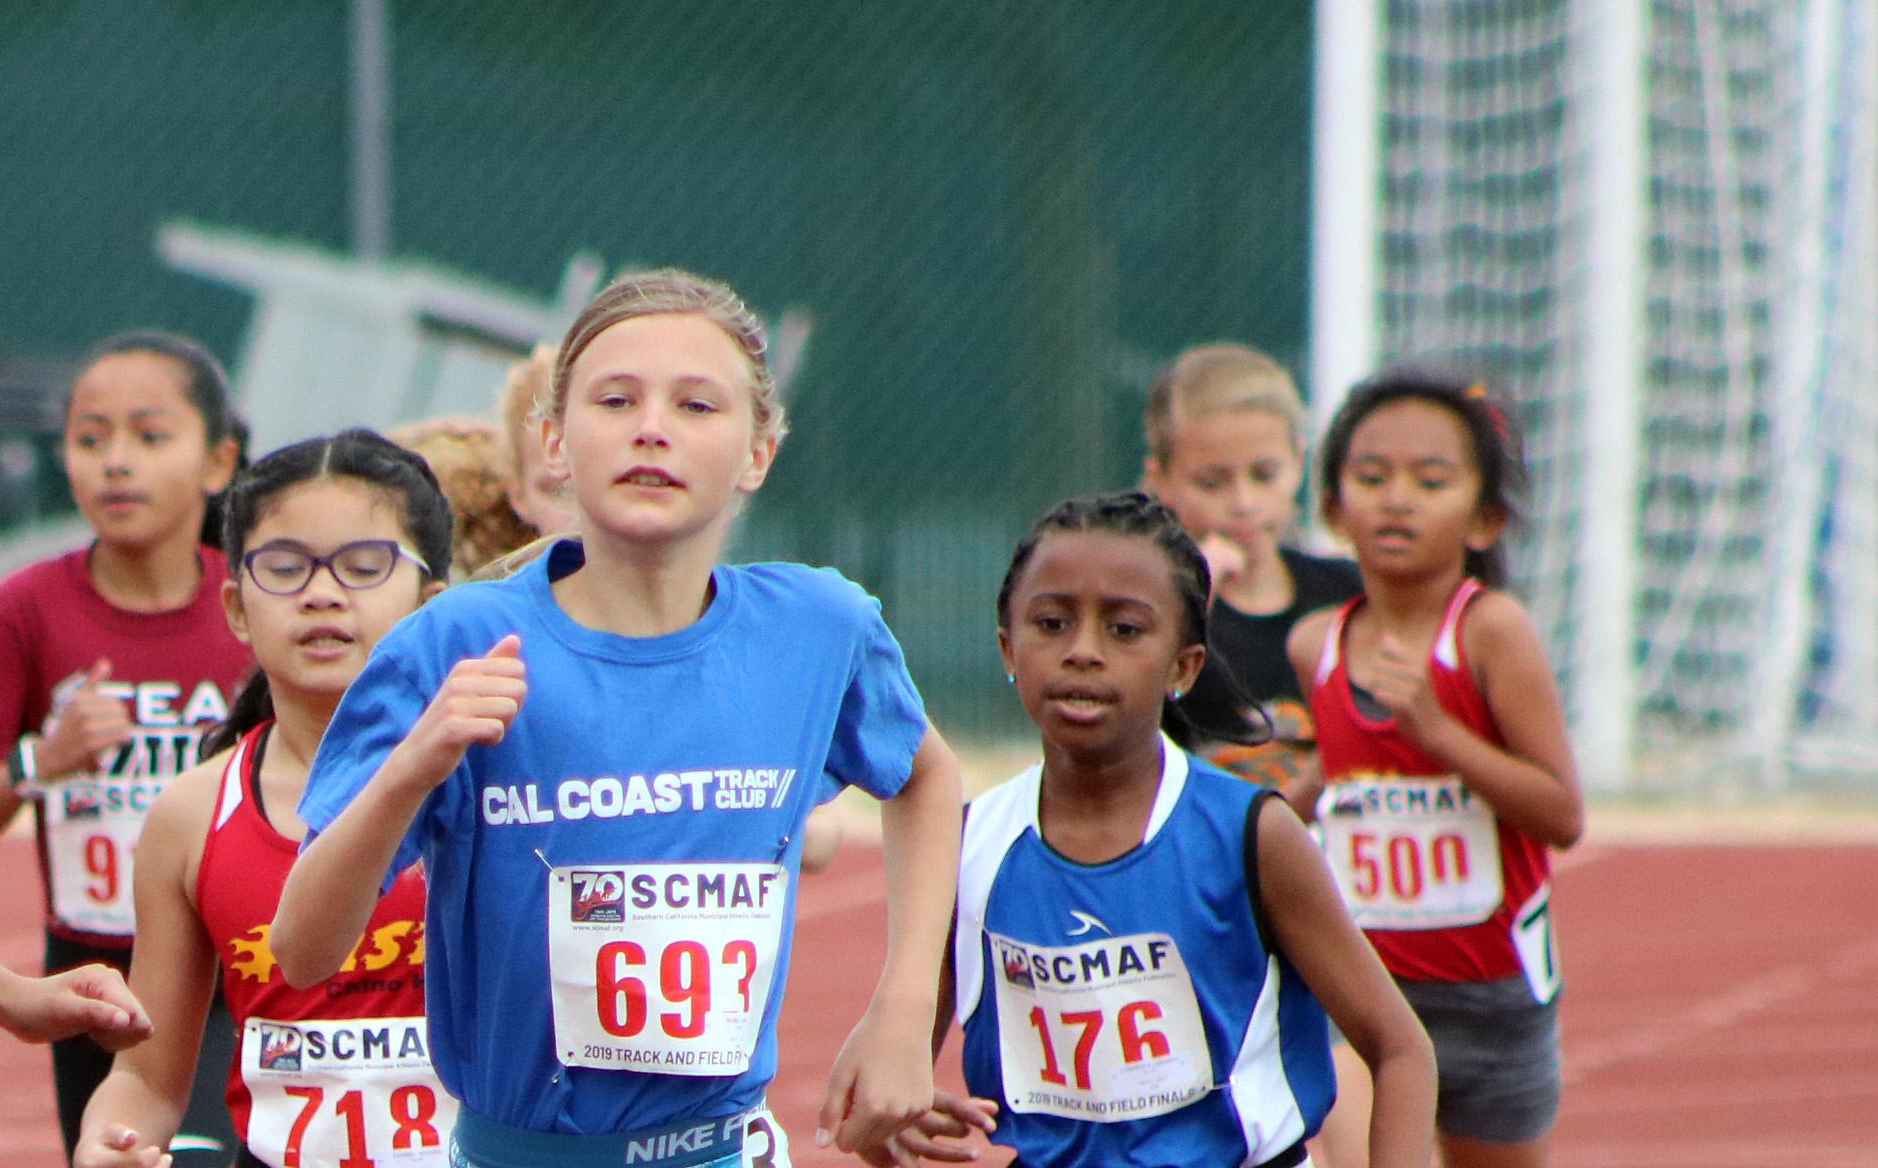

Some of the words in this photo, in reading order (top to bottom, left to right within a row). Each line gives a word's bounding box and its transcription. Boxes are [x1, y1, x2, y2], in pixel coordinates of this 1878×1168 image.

[482, 784, 554, 825] CAL
[557, 771, 713, 820] COAST
[714, 769, 779, 788] TRACK
[714, 788, 767, 809] CLUB
[1351, 834, 1468, 904] 500
[631, 873, 774, 909] SCMAF
[1032, 940, 1171, 984] SCMAF
[584, 1045, 612, 1060] 2019
[615, 1048, 660, 1064] TRACK
[665, 1050, 695, 1065] AND
[698, 1050, 733, 1065] FIELD
[1029, 999, 1171, 1091] 176
[1109, 1098, 1147, 1113] FIELD
[626, 1122, 716, 1165] NIKE
